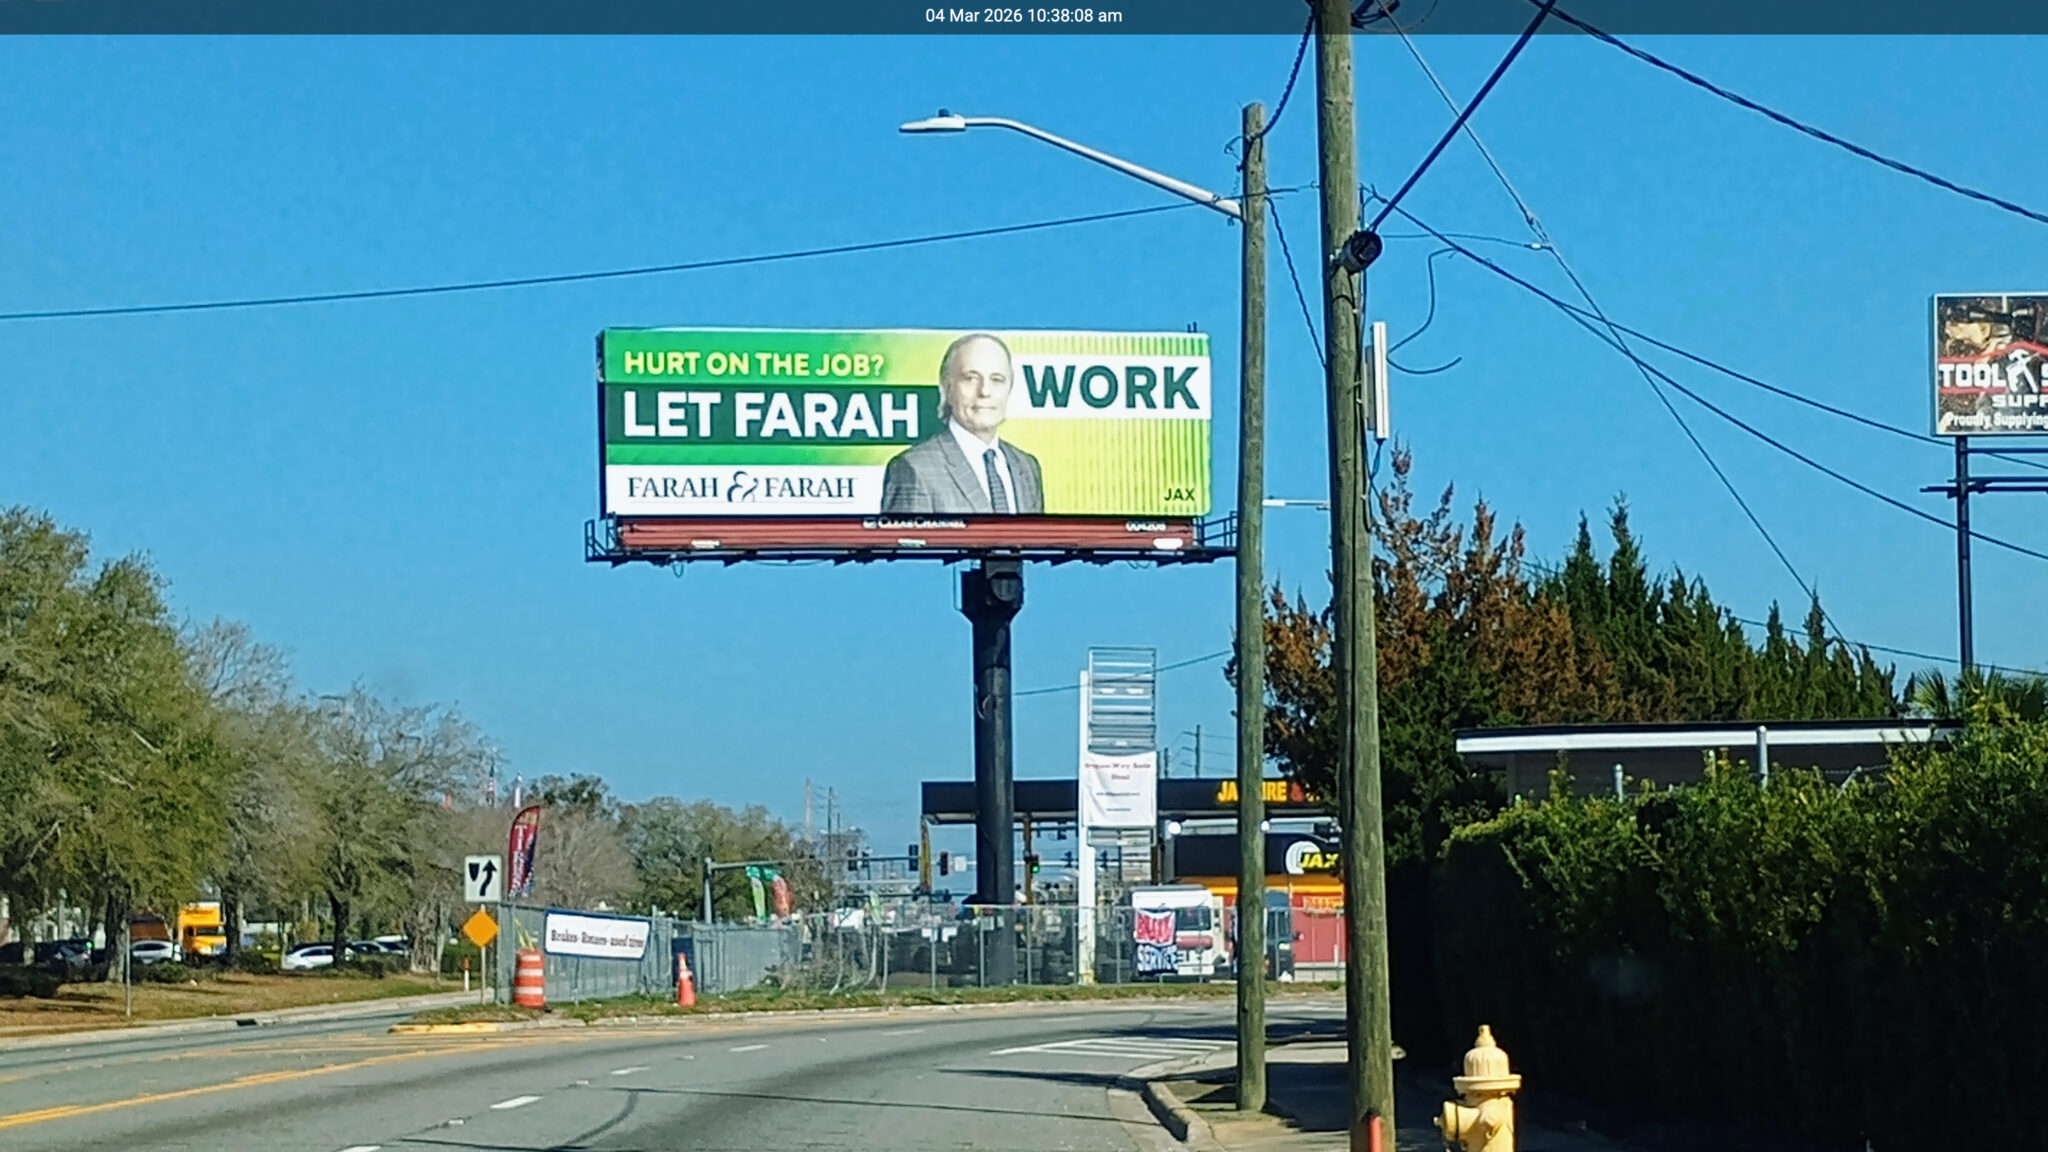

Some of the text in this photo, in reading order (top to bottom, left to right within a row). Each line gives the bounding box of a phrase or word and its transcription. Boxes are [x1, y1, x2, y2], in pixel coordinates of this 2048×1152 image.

[624, 351, 885, 377] HURT ON THE JOB?
[1938, 363, 2007, 388] TOOL
[1022, 365, 1200, 409] WORK
[624, 391, 918, 437] LET FARAH
[1943, 412, 1992, 430] Proudly
[628, 470, 856, 503] FARAH & FARAH
[1163, 488, 1195, 501] JAX
[1261, 781, 1288, 802] IRE
[1299, 853, 1339, 868] JAX
